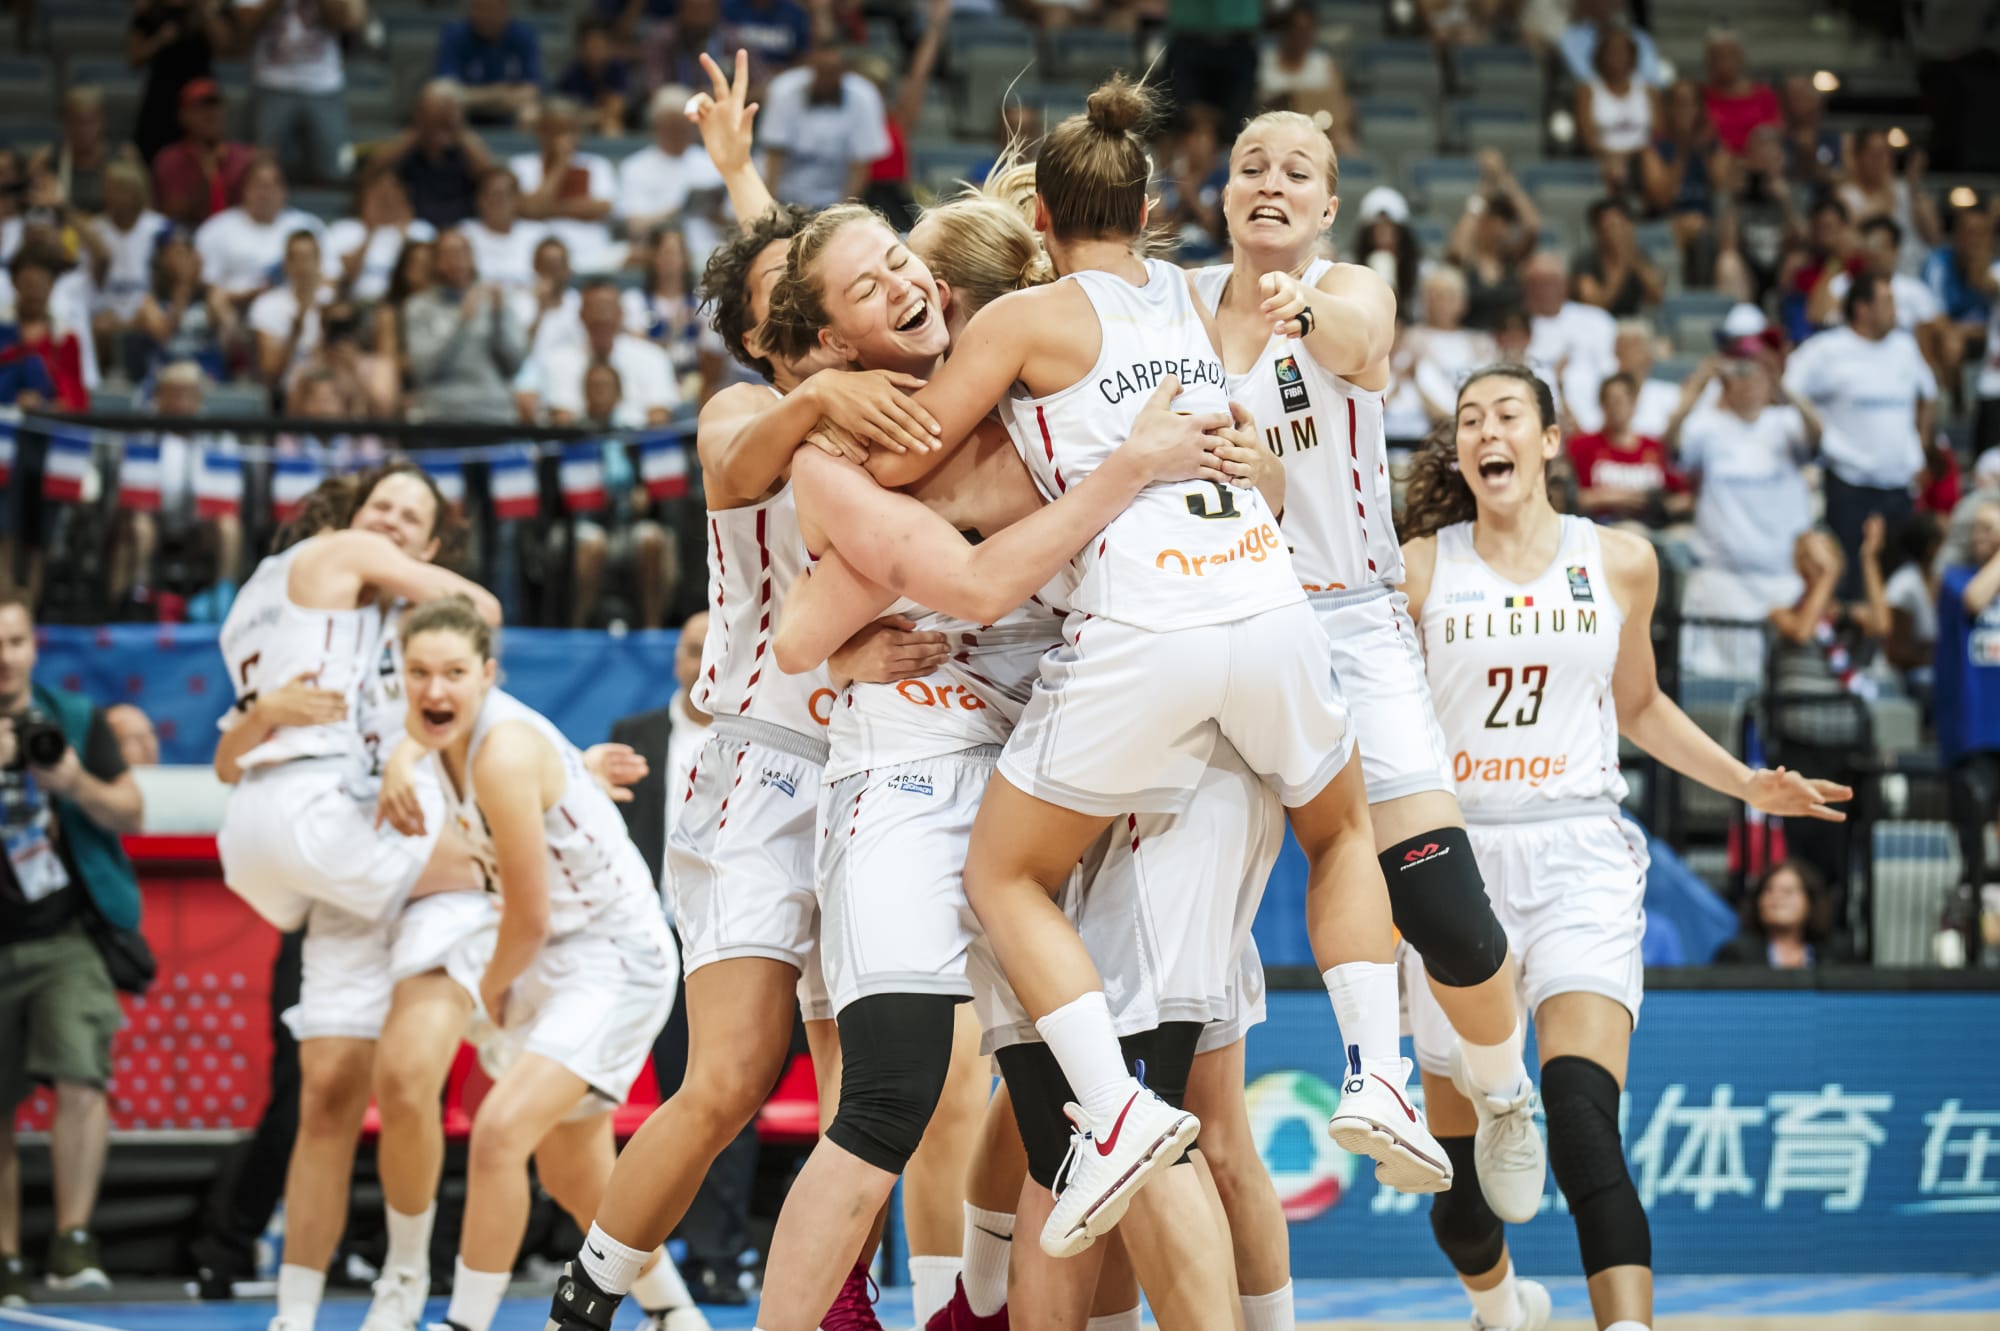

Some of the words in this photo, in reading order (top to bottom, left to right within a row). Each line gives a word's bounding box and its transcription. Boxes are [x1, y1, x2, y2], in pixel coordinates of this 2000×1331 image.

[1284, 385, 1304, 399] FIBA
[1445, 608, 1596, 645] BELGIUM
[896, 680, 987, 711] Ora
[1484, 665, 1549, 729] 23
[1453, 750, 1568, 788] Orange
